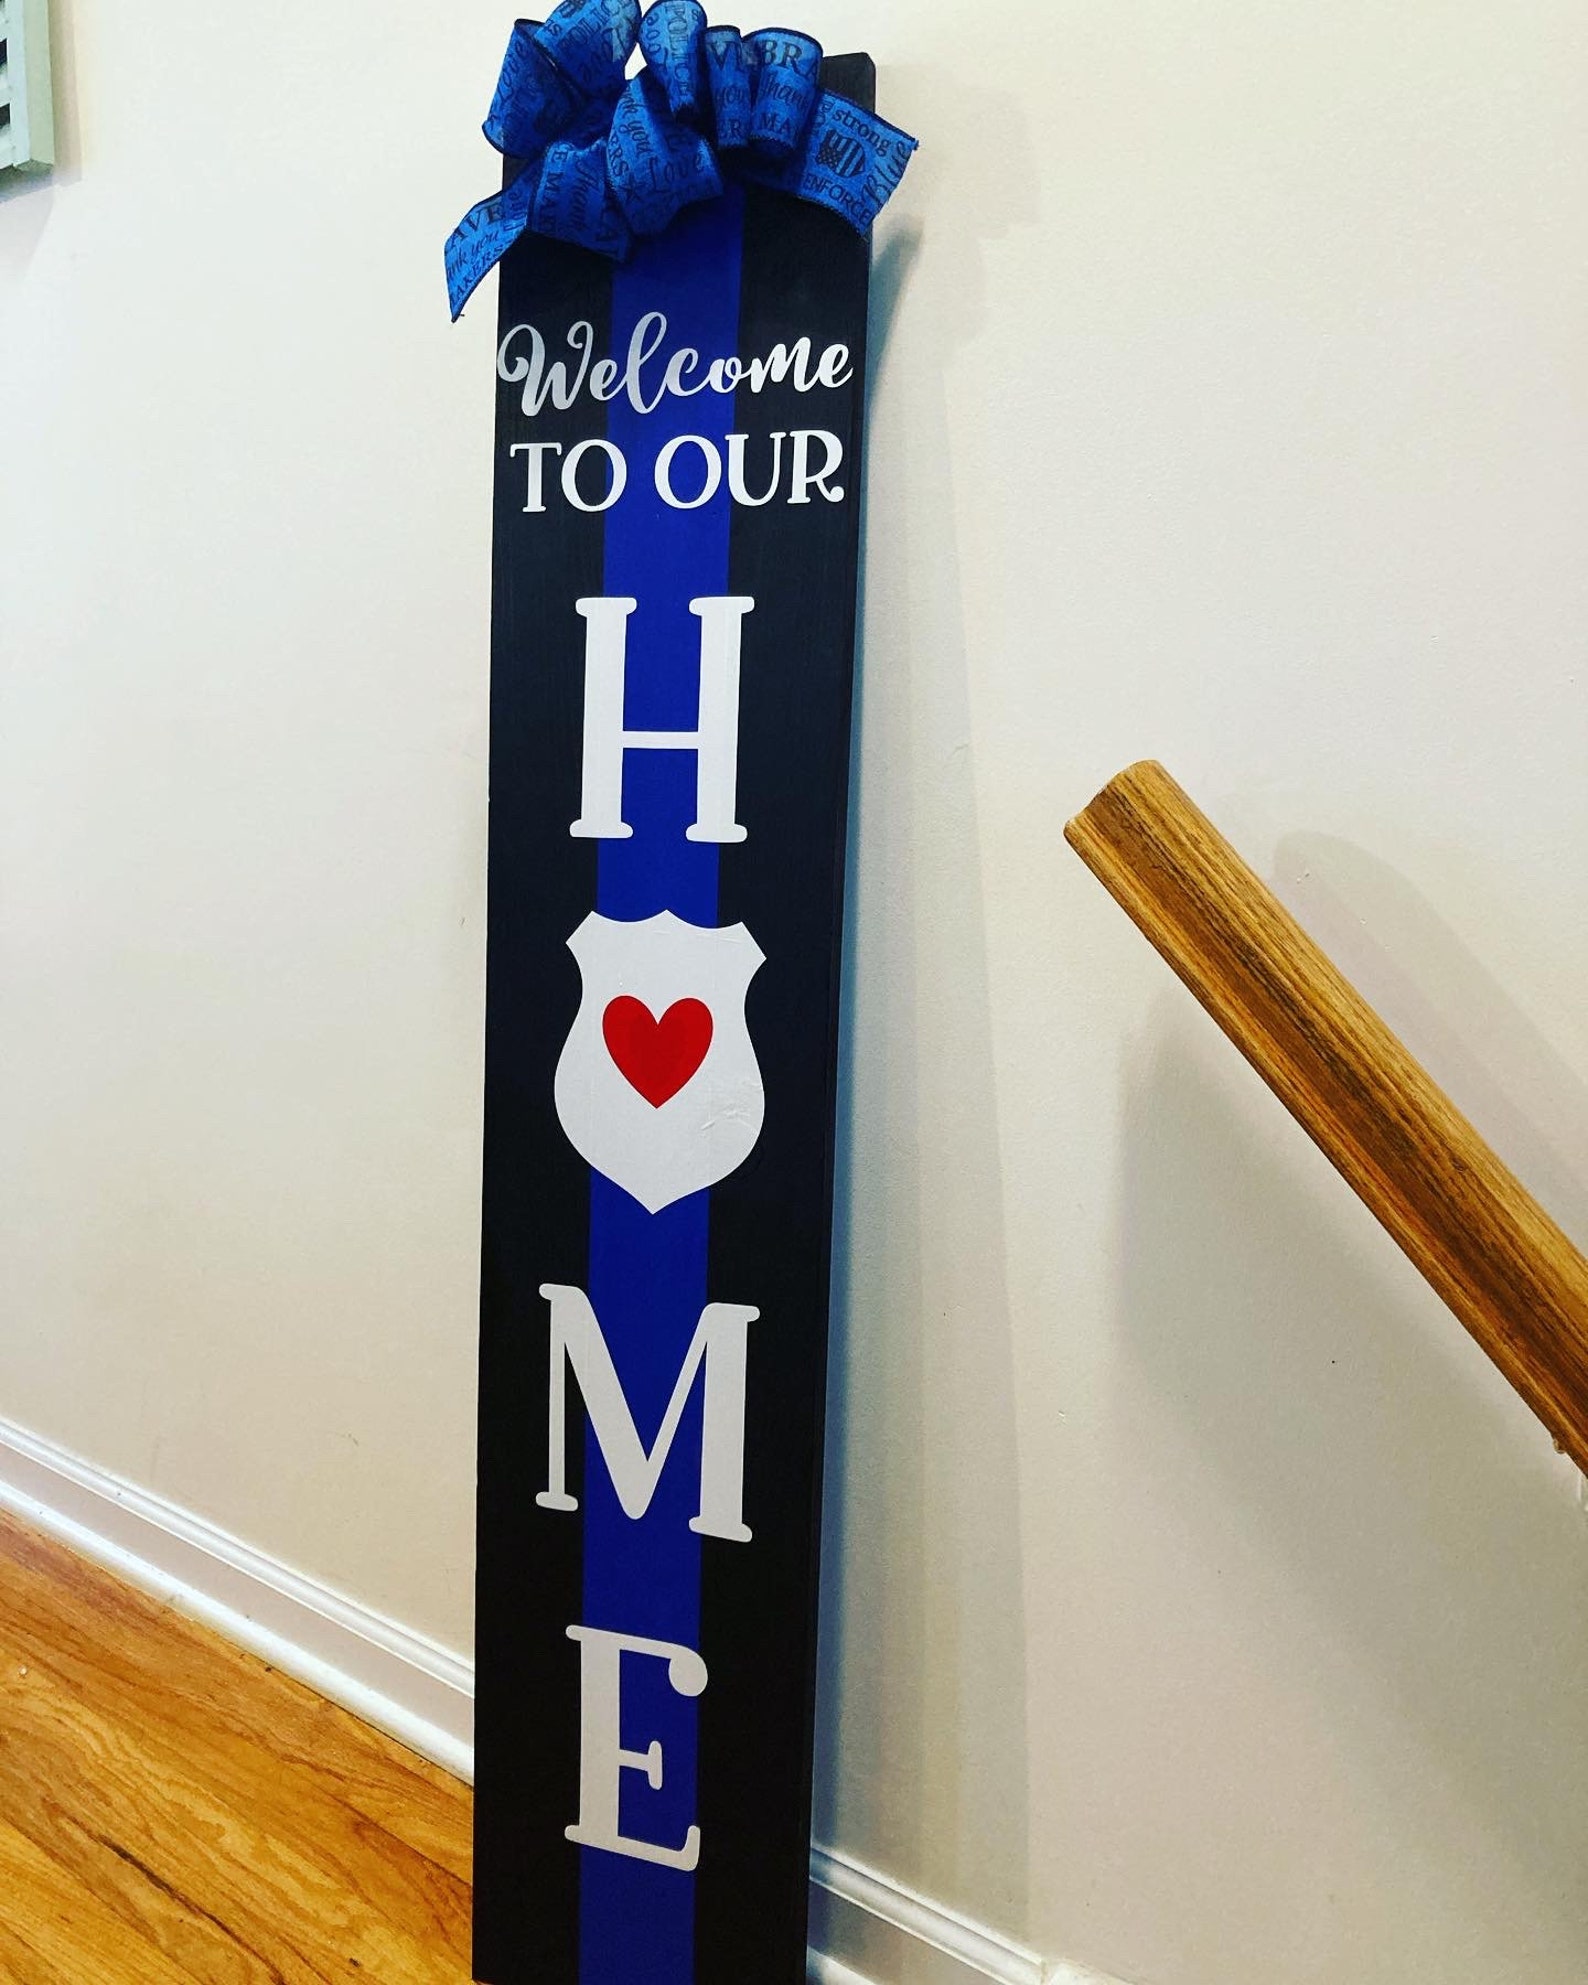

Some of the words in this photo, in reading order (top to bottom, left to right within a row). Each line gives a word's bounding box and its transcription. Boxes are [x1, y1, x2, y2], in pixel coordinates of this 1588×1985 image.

[832, 108, 891, 157] strong
[497, 311, 853, 417] Welcome
[509, 438, 628, 513] TO
[653, 429, 845, 509] OUR
